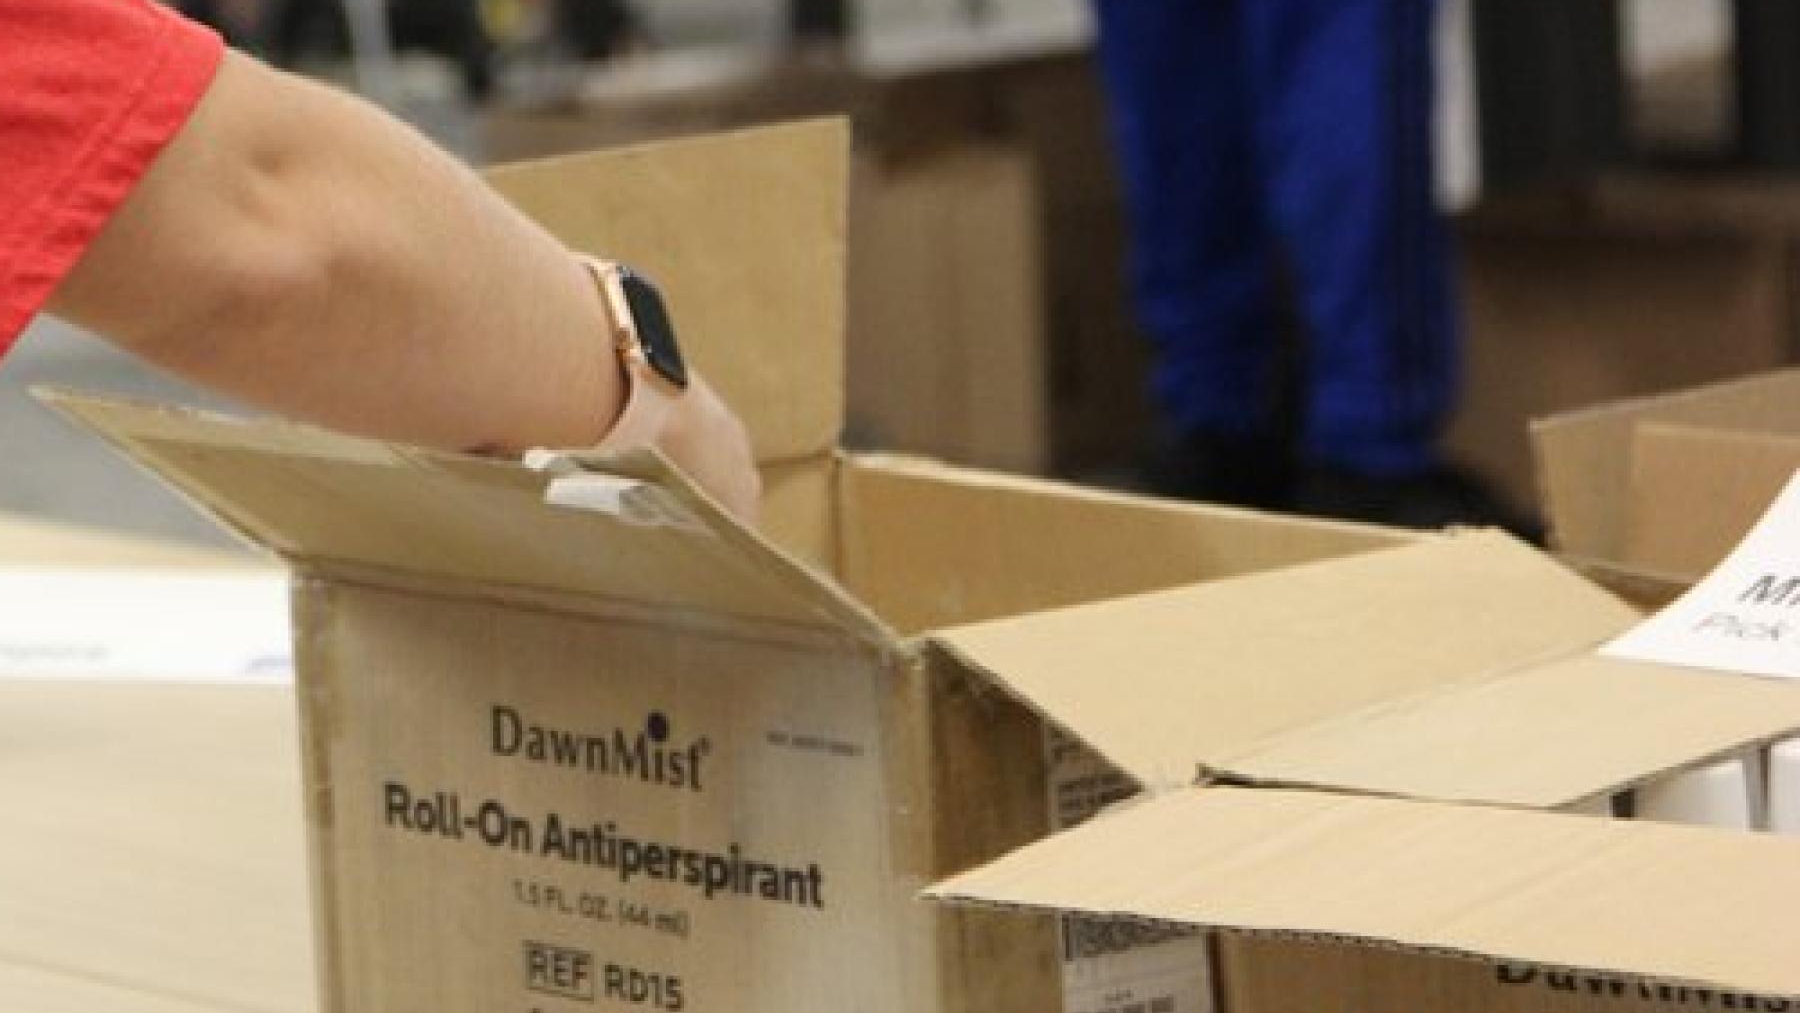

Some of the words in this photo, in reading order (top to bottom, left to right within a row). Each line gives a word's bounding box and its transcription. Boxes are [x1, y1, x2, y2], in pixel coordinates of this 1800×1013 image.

[491, 704, 703, 793] DawnMist
[383, 782, 533, 852] Roll-On
[540, 813, 825, 909] Antiperspirant
[528, 948, 591, 992] REF
[603, 962, 685, 1013] RD15
